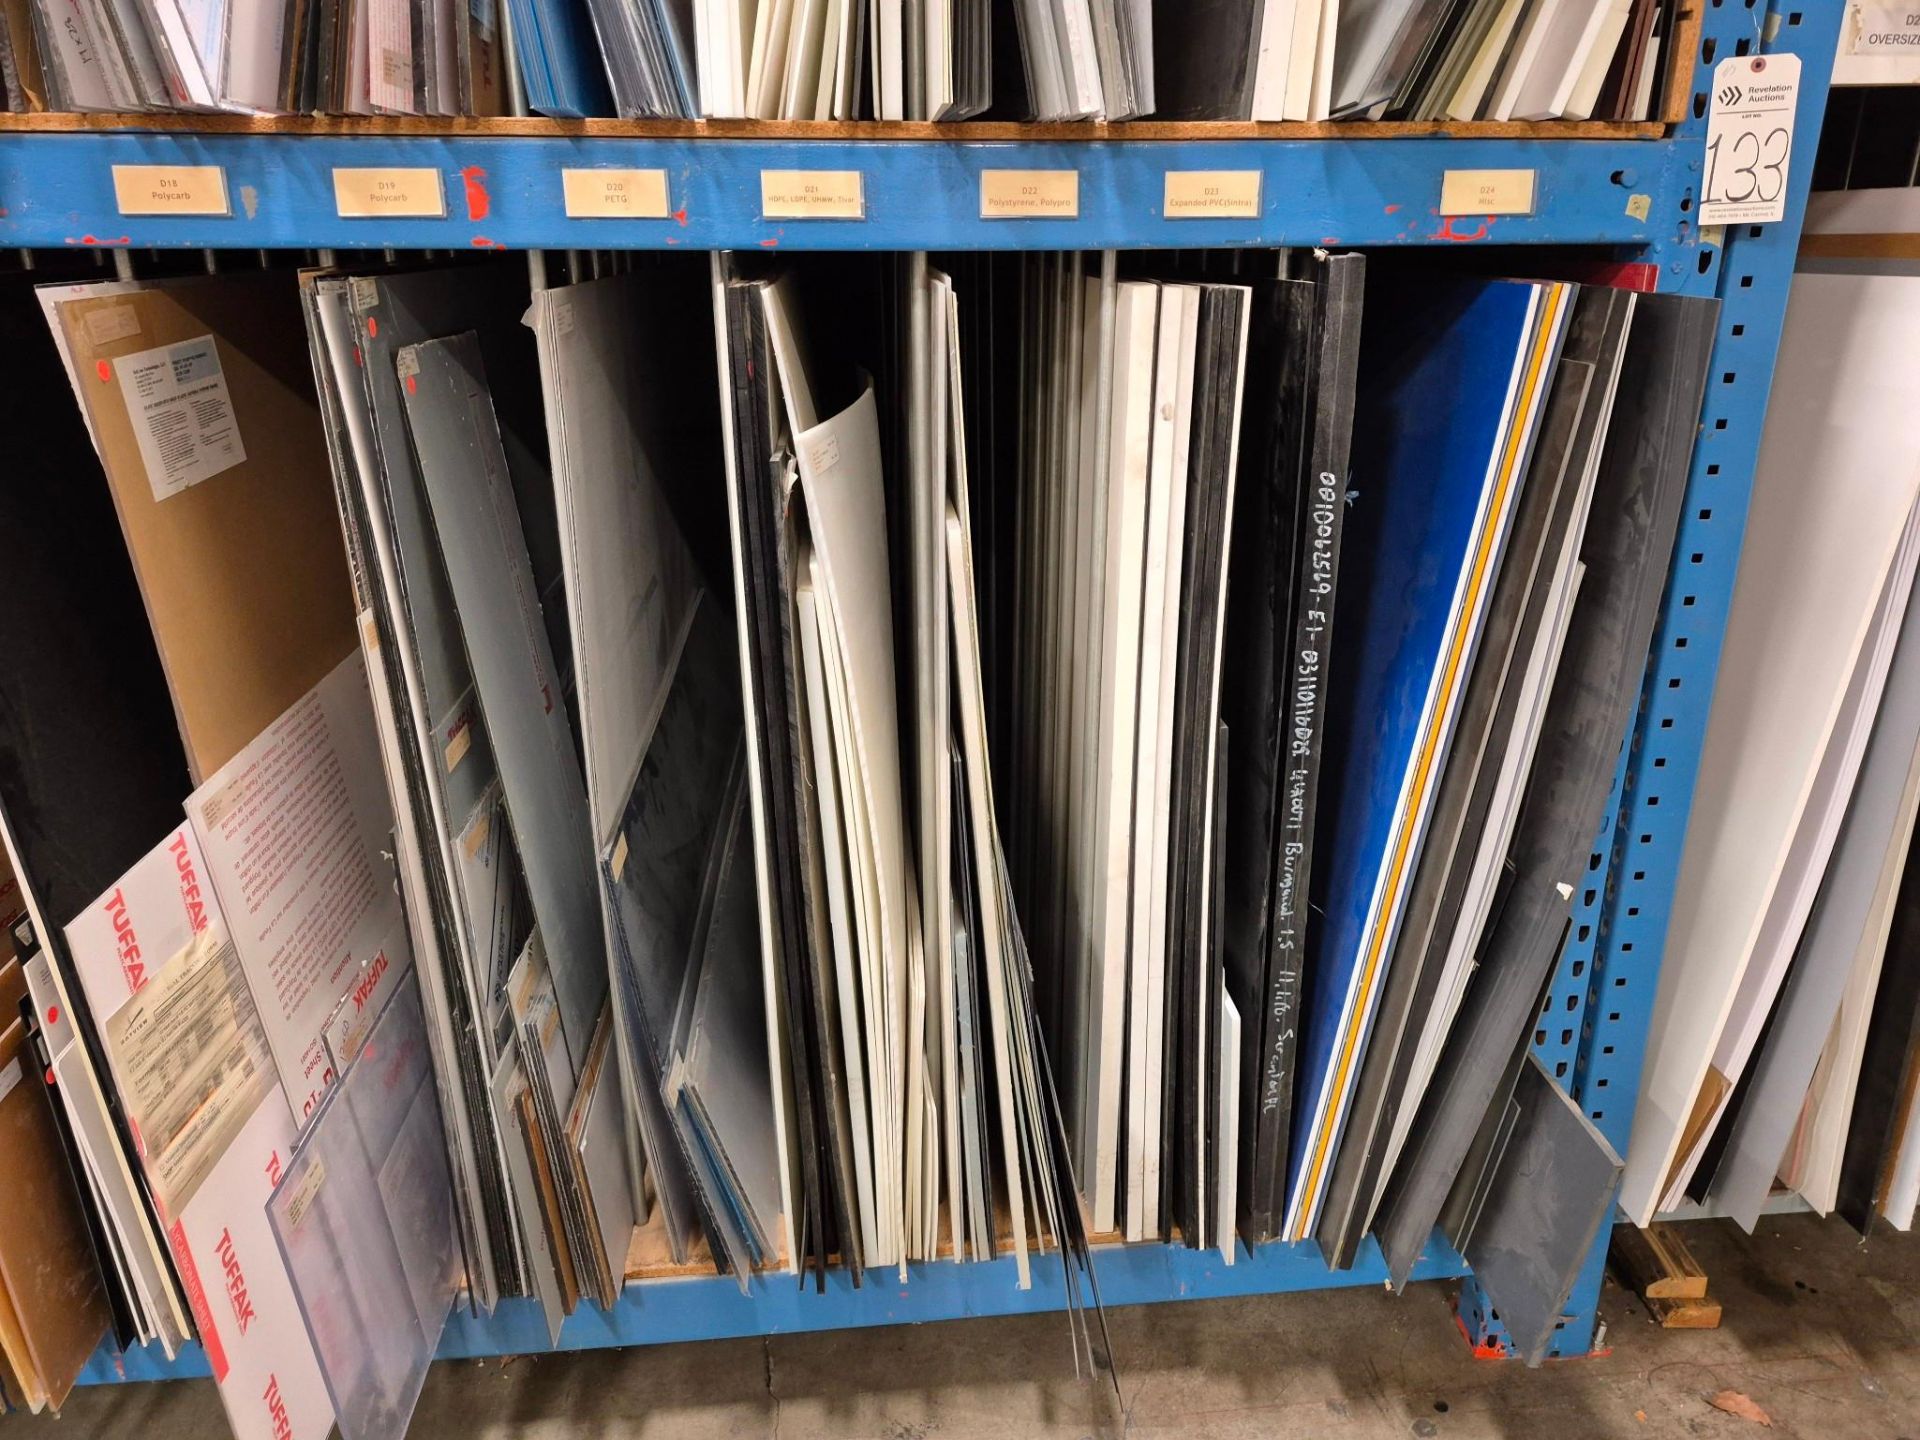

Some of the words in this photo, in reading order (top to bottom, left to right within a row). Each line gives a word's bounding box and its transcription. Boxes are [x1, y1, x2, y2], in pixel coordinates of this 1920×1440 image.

[1906, 14, 1920, 26] D2
[1748, 85, 1793, 94] Revelation
[1748, 94, 1785, 103] Auctions
[1700, 127, 1790, 205] 133
[159, 179, 178, 188] D18
[378, 181, 396, 190] D19
[606, 183, 624, 192] D20
[151, 190, 191, 202] Polycarb
[1022, 186, 1038, 196] D22
[369, 192, 408, 204] Polycarb
[604, 194, 628, 204] PETG
[988, 198, 1039, 208] Polystyrene,
[1040, 198, 1071, 208] Polypro
[1170, 198, 1207, 208] Expanded
[352, 949, 389, 1014] TUFFAK
[304, 1052, 322, 1080] Sheet
[214, 1226, 255, 1337] TUFFAK
[263, 1373, 292, 1440] TUFF
